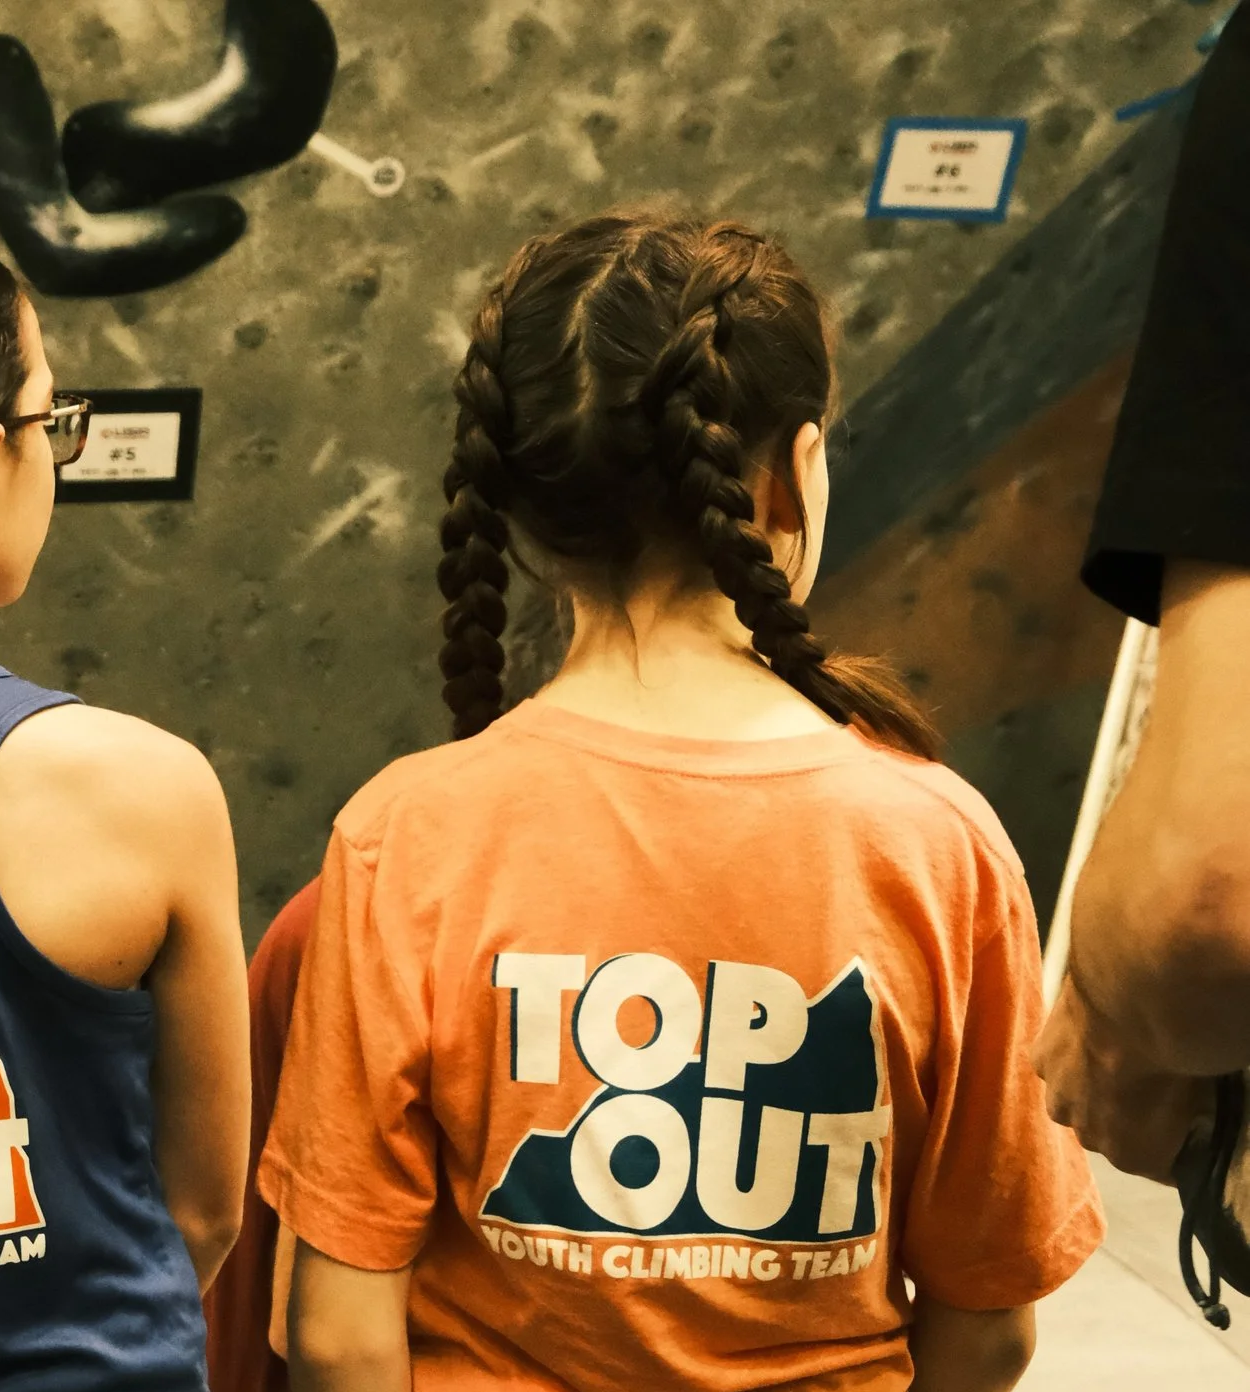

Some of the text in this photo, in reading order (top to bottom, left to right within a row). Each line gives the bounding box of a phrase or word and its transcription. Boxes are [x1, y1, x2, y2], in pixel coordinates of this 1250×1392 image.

[494, 952, 809, 1091] TOP
[570, 1093, 893, 1235] OUT
[481, 1225, 877, 1281] YOUTH CLIMBING TEAM
